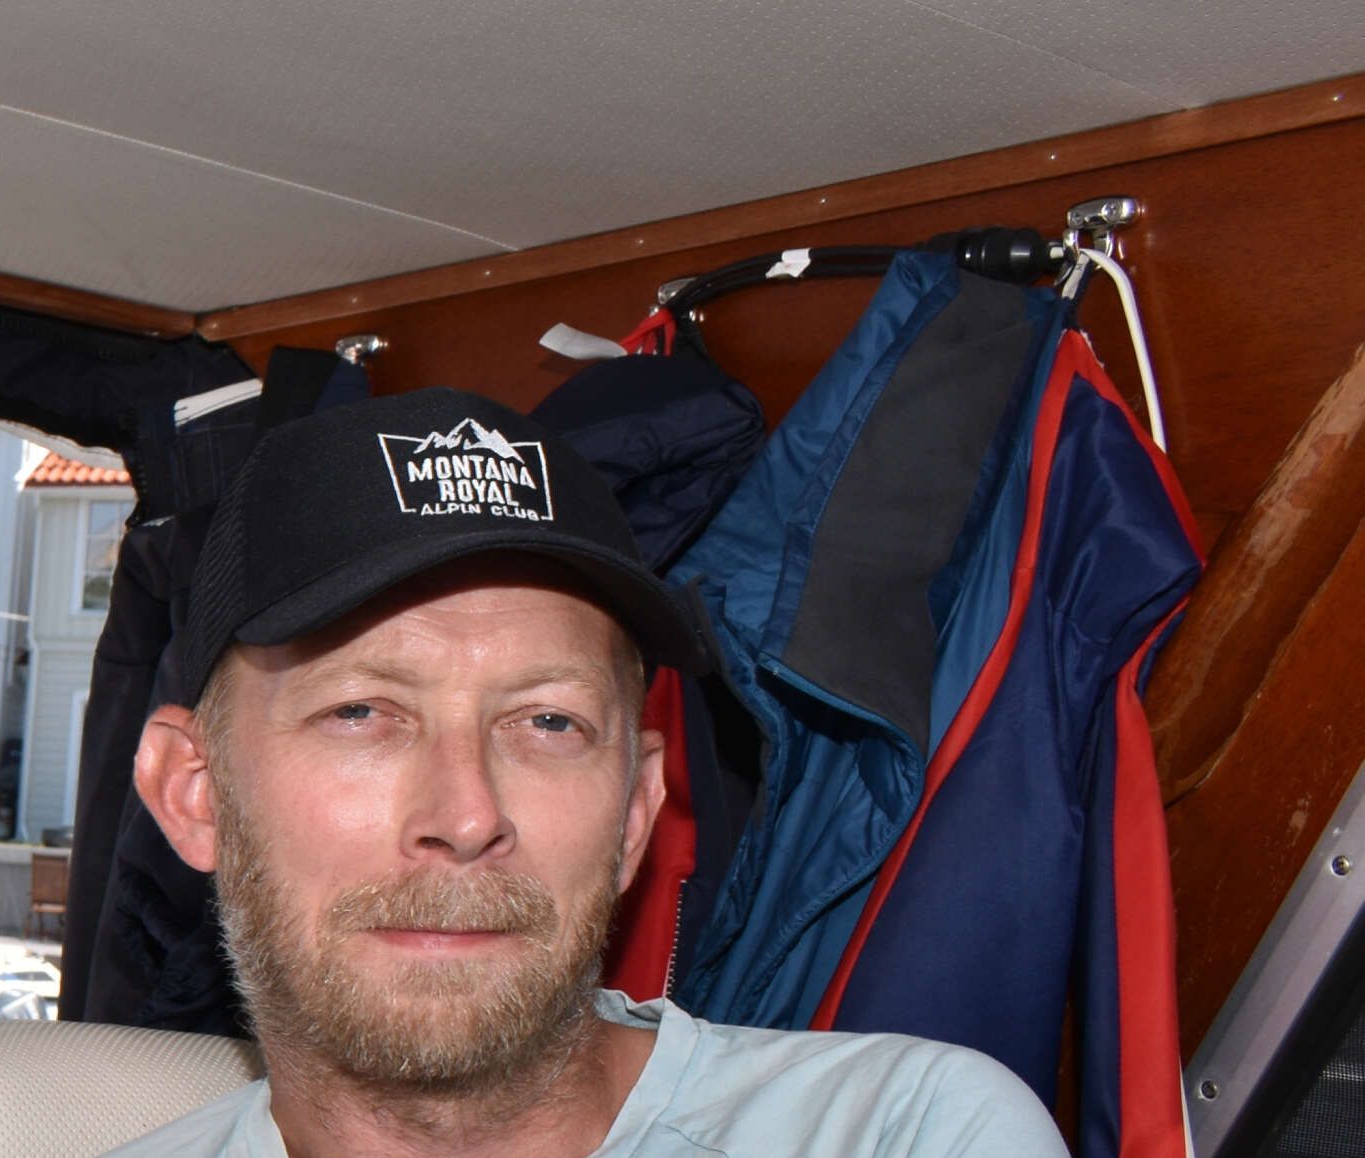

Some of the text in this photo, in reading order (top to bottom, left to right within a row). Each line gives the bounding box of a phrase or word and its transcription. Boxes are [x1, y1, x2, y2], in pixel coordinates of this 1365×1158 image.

[408, 455, 537, 489] MONTANA
[439, 480, 519, 506] ROYAL
[420, 503, 540, 521] ALPIN CLUB
